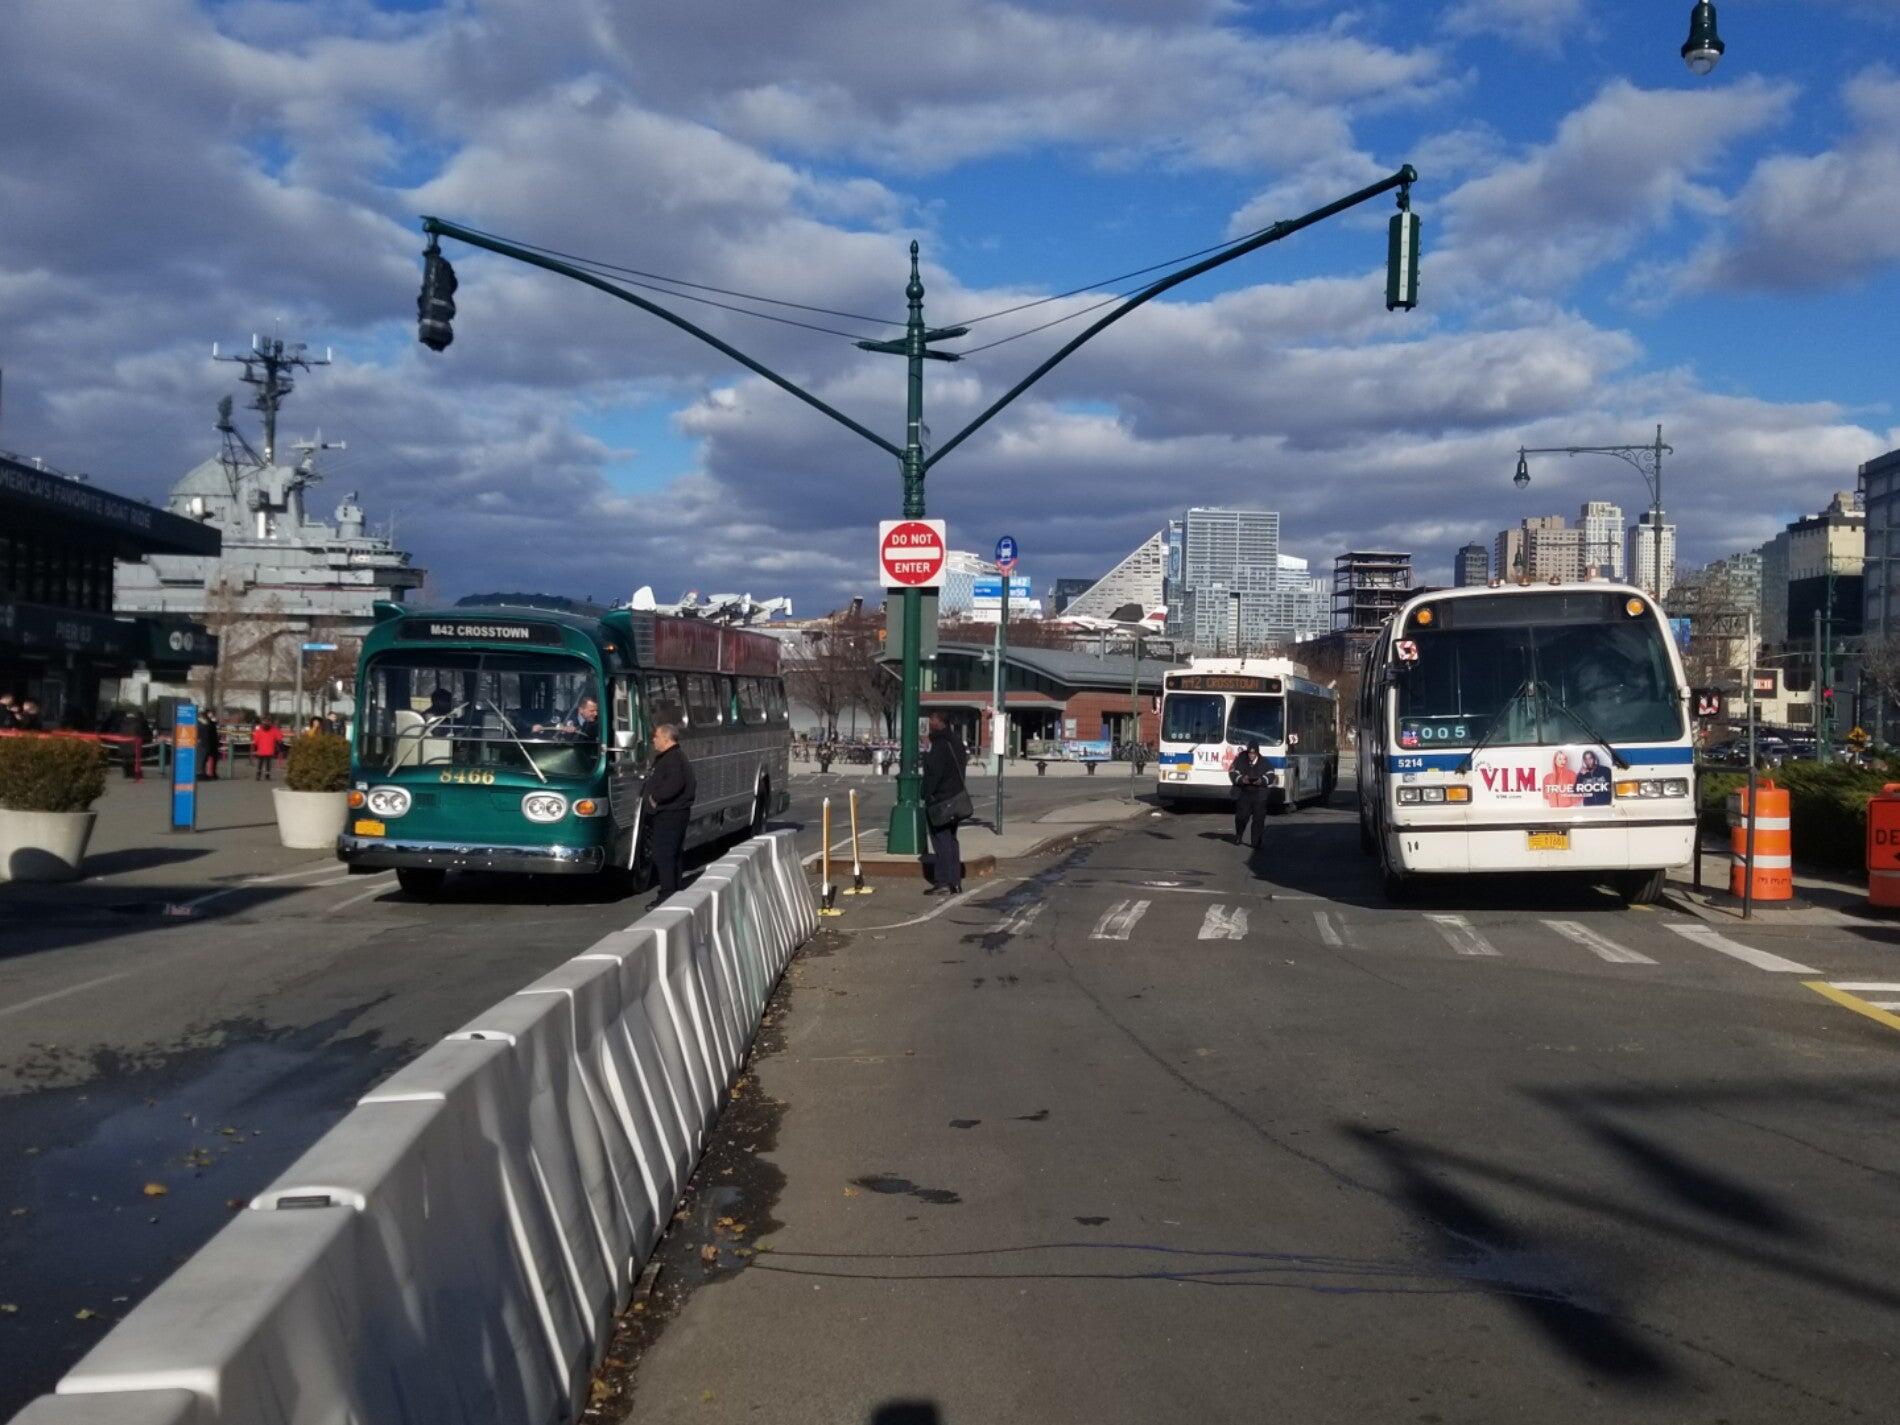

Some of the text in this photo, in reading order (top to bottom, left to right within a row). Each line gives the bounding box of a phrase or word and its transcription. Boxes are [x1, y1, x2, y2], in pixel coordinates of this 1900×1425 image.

[892, 533, 932, 545] DO NOT
[895, 562, 930, 574] ENTER
[430, 624, 529, 639] M42 CROSSTOWN
[1398, 758, 1423, 768] 5214
[440, 769, 495, 785] 8466
[1544, 782, 1609, 794] TRUE ROCK
